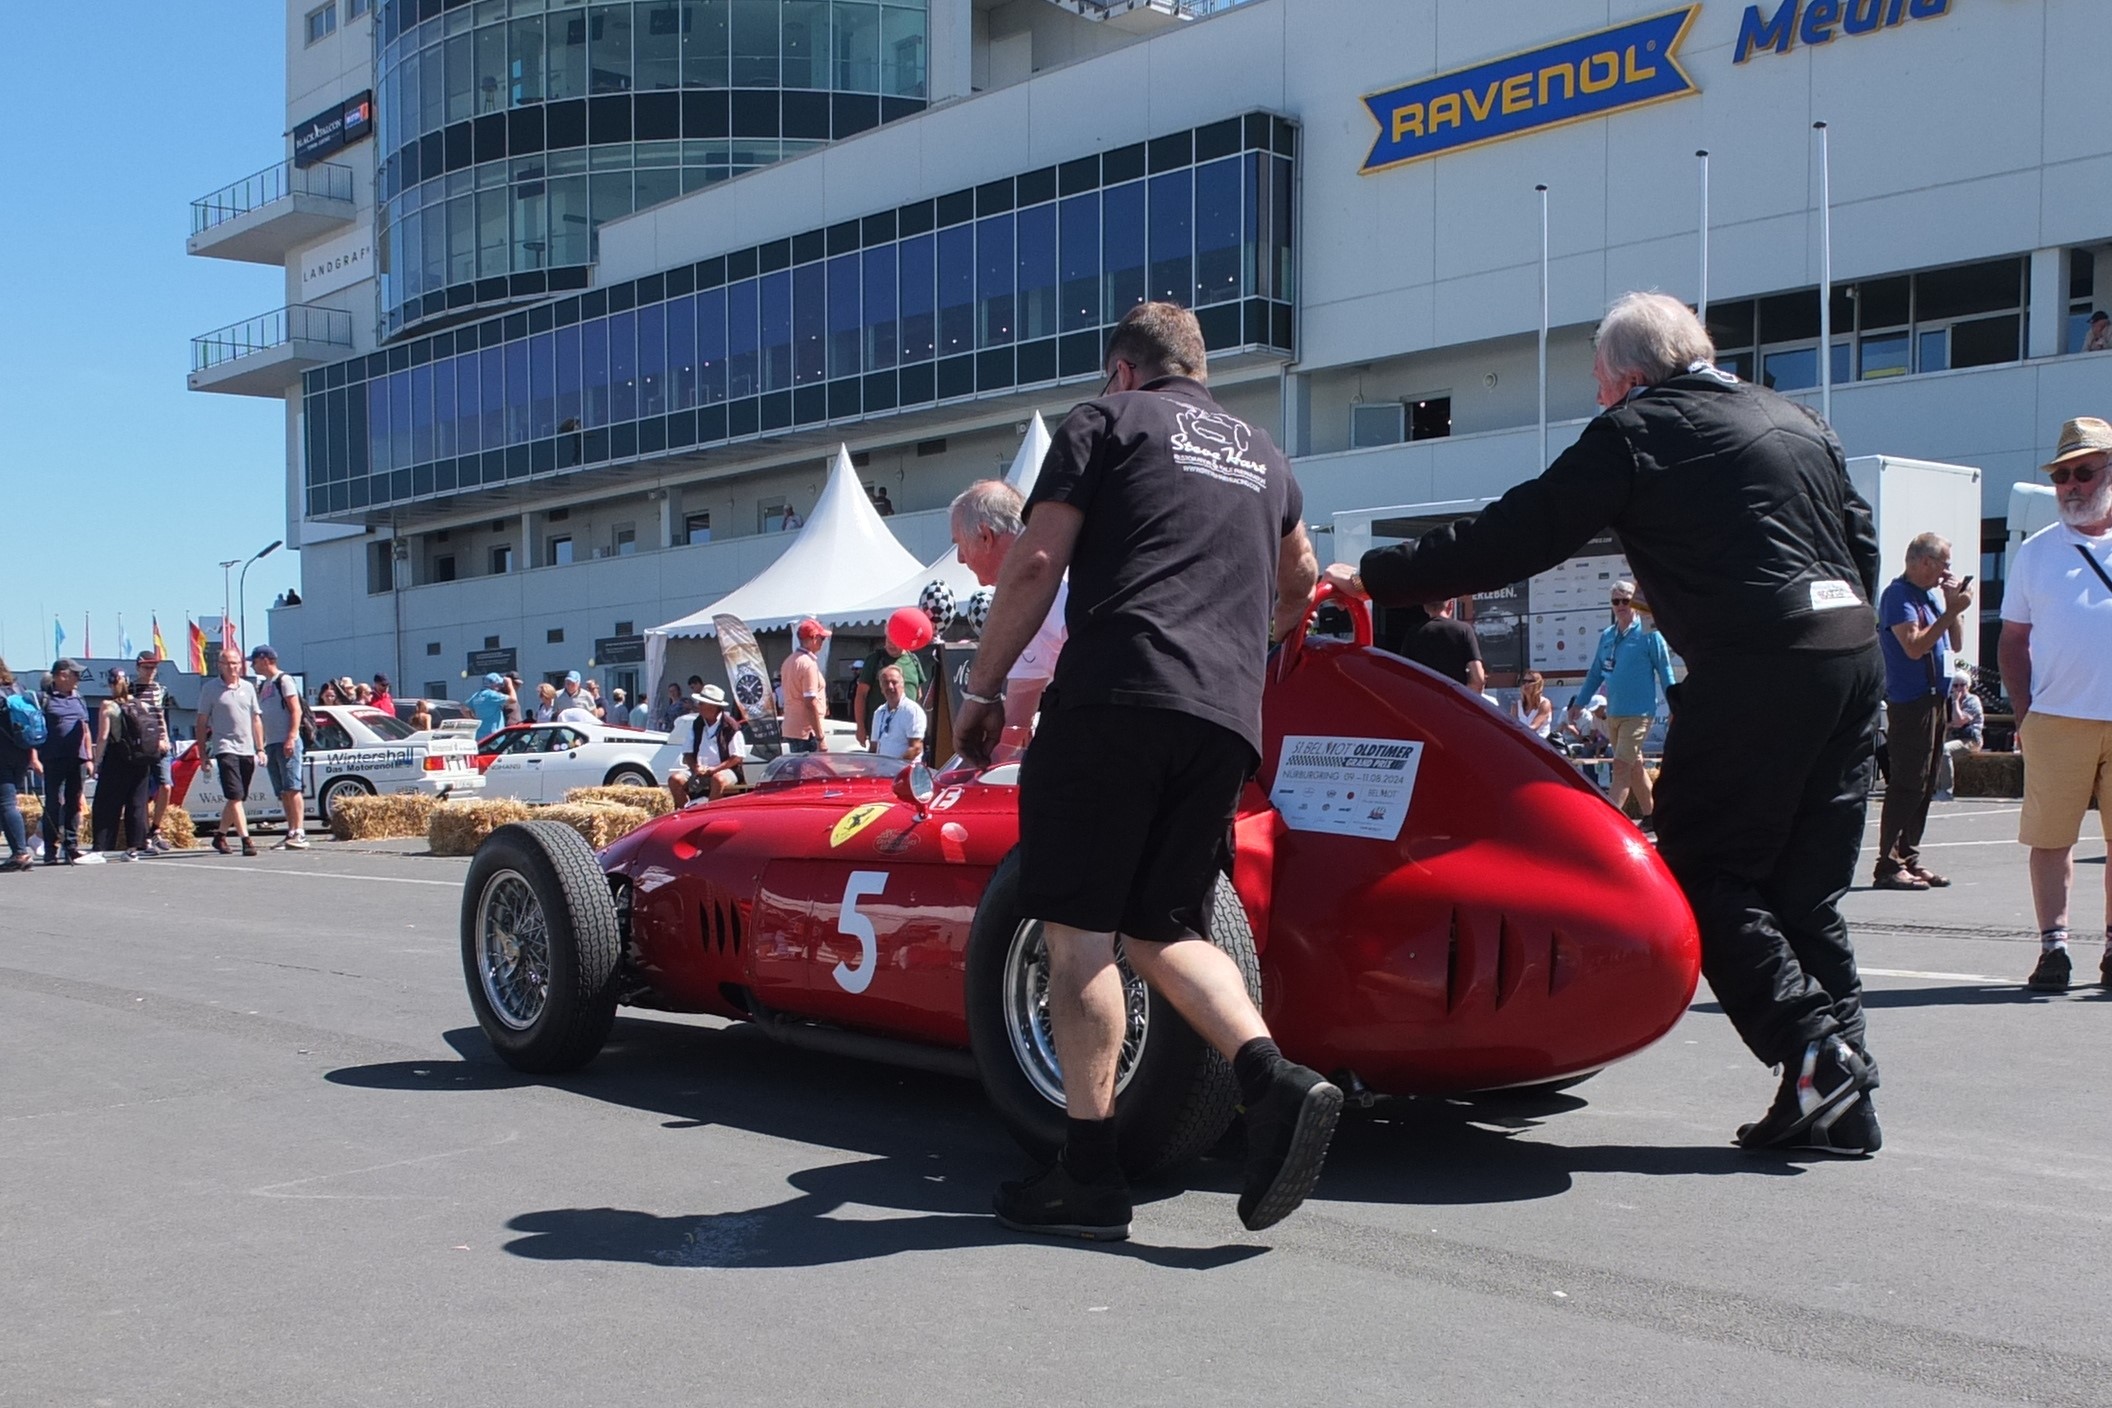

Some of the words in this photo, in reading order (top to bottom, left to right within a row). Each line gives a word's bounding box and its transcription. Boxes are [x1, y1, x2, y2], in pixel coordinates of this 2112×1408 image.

[1391, 44, 1657, 144] RAVENOL
[296, 131, 315, 149] BLACK
[1170, 433, 1221, 461] Steve
[1220, 446, 1267, 475] Hart
[327, 745, 414, 765] Wintershall
[1353, 743, 1414, 758] OLDTIMER
[326, 765, 343, 774] Das
[1345, 758, 1372, 767] GRAND
[1372, 759, 1393, 769] PRIX
[199, 792, 267, 804] WARNER
[831, 870, 890, 995] 5
